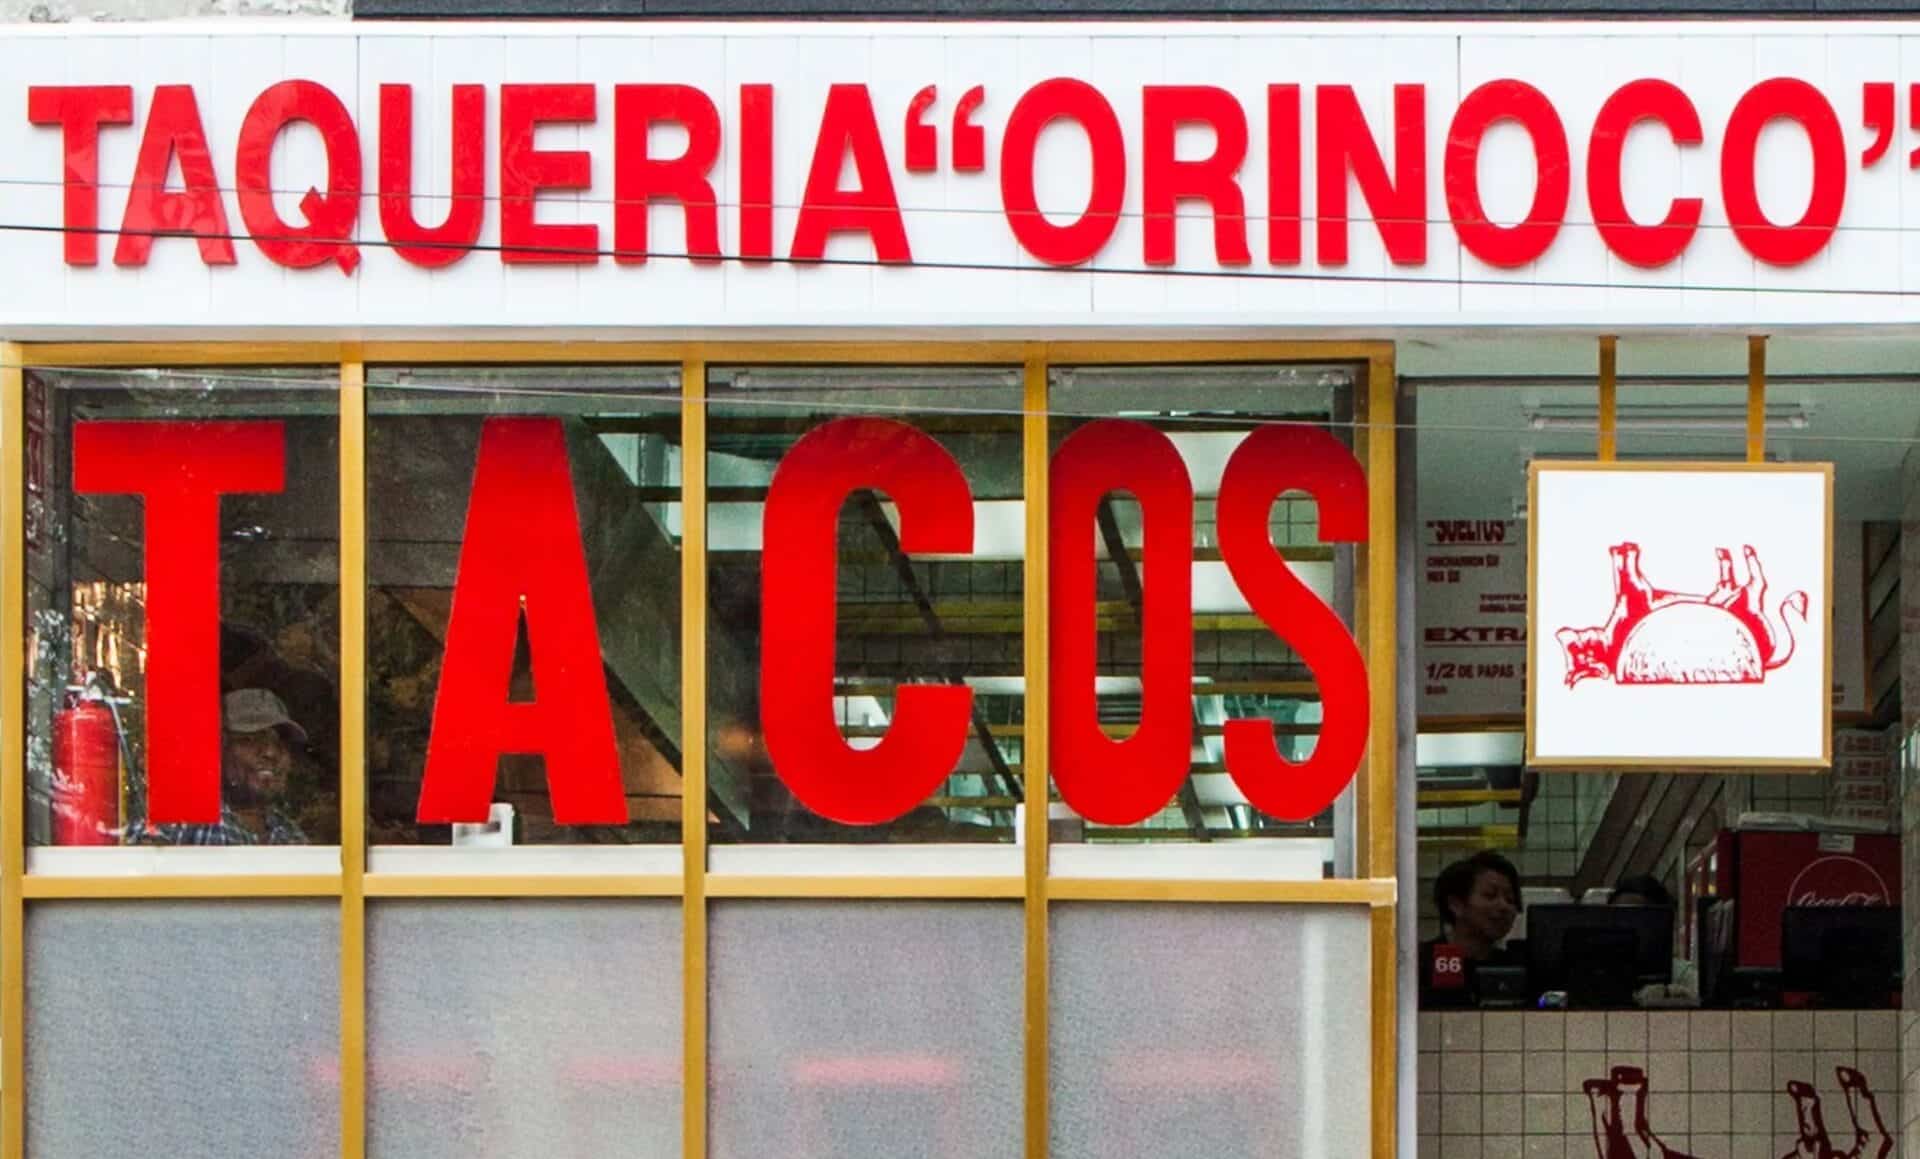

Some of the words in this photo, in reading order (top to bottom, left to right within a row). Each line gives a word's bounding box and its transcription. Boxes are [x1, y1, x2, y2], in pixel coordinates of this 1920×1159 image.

[28, 81, 912, 278] TAQUERIA
[72, 417, 1370, 827] TACOS
[1426, 662, 1456, 680] 1/2
[1457, 663, 1473, 679] DE
[1477, 663, 1515, 679] PAPAS
